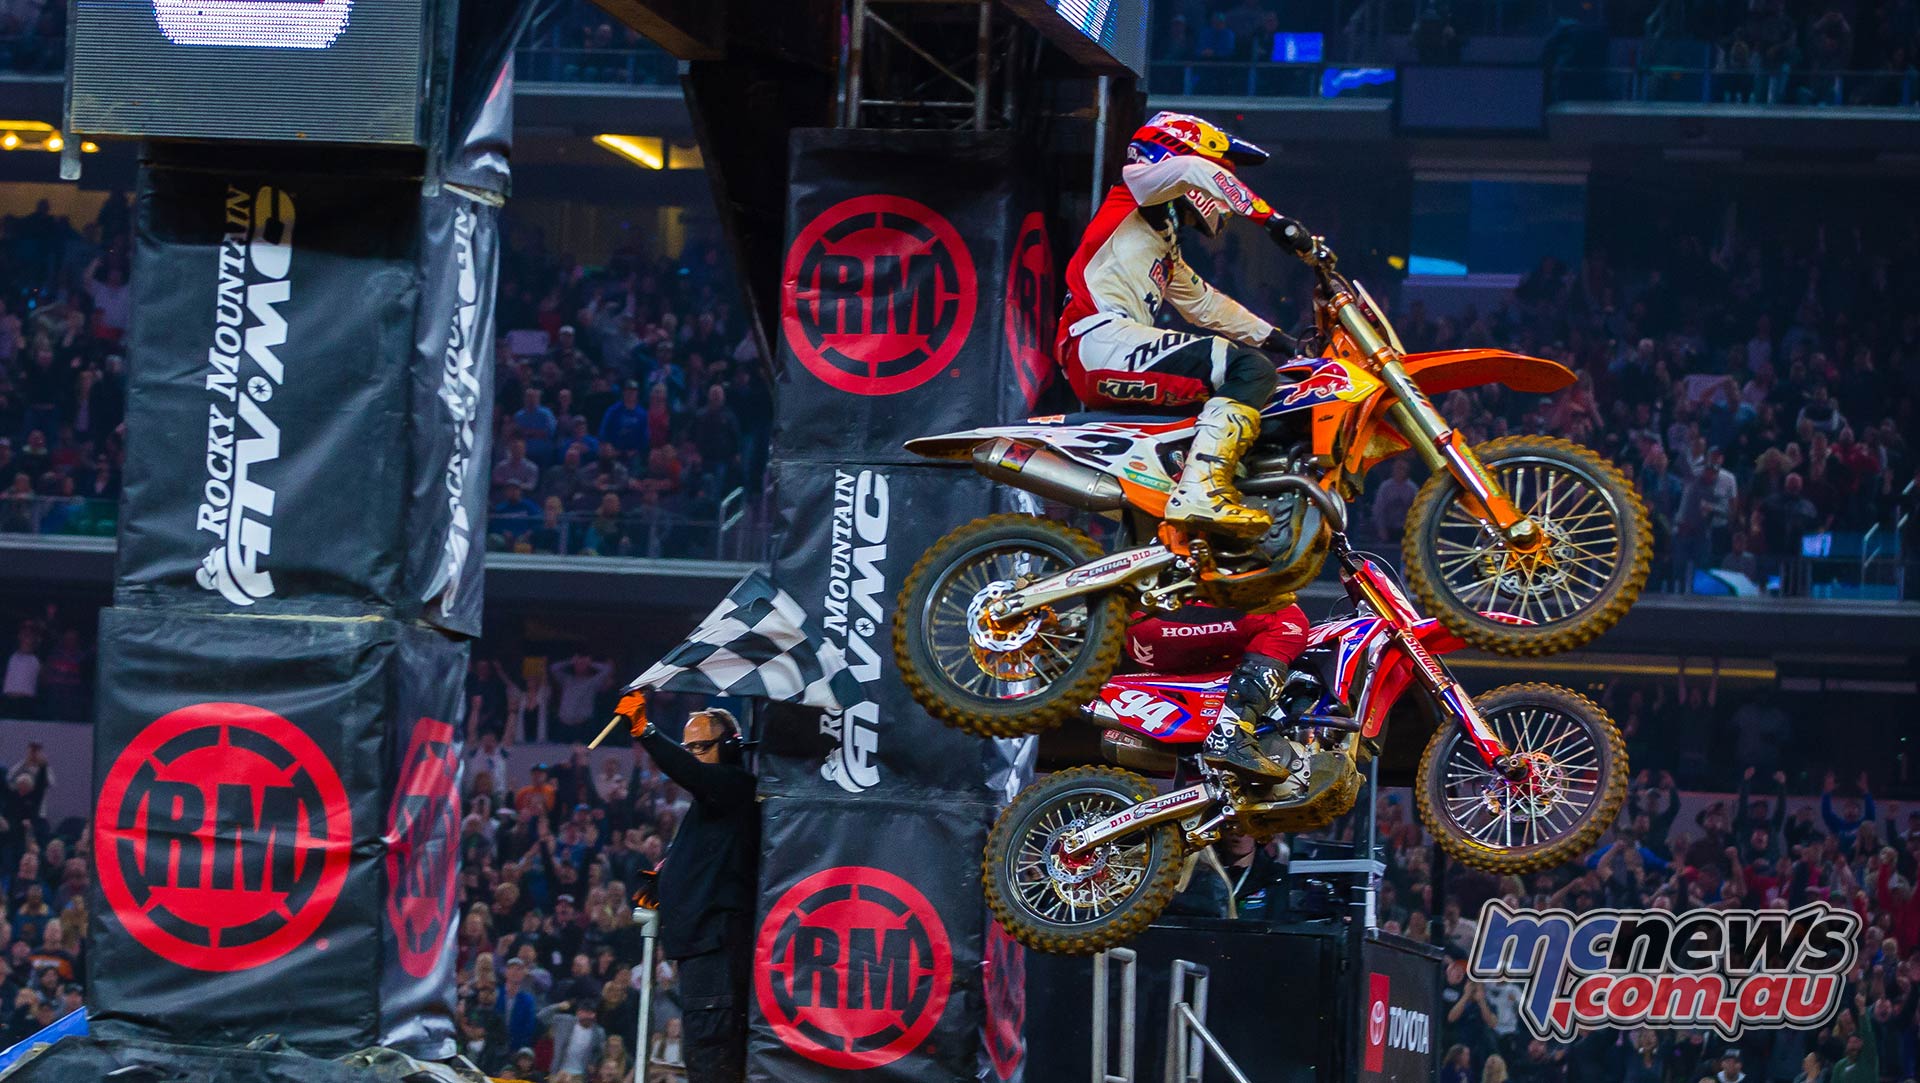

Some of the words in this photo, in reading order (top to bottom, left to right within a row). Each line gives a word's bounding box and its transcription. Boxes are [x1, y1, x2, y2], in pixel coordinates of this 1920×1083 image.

[206, 184, 252, 402] MOUNTAIN
[818, 255, 938, 334] RM
[1098, 380, 1157, 400] KTM
[197, 404, 235, 540] ROCKY
[823, 469, 857, 637] MOUNTAIN
[1161, 621, 1237, 638] HONDA
[1404, 637, 1441, 675] SHOWA
[1110, 689, 1180, 732] 94
[147, 782, 301, 892] RM
[791, 927, 915, 1011] RM
[1388, 1006, 1429, 1054] TOYOTA
